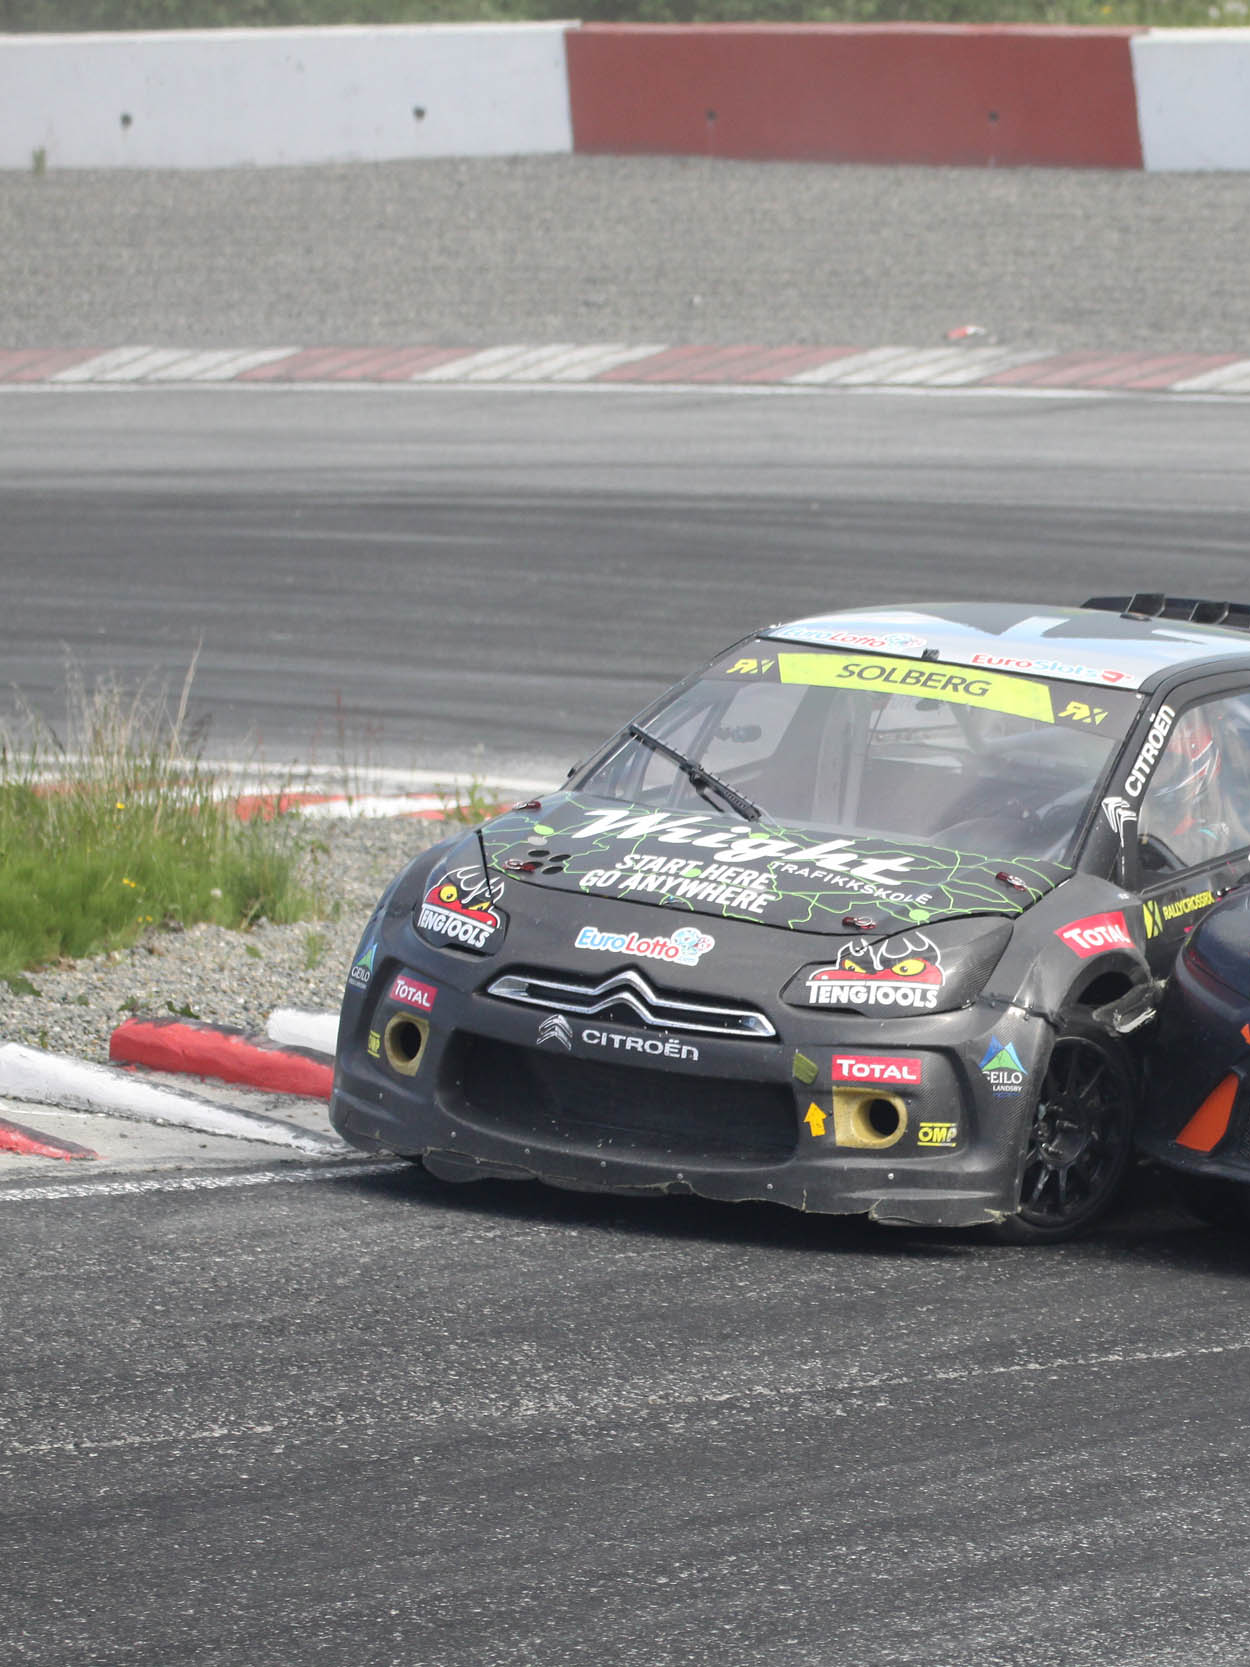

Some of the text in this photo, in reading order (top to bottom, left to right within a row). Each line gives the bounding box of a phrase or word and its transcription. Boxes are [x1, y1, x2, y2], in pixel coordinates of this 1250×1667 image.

[836, 663, 992, 698] SOLBERG
[615, 853, 779, 891] START HERE
[770, 861, 933, 906] TRAFIKKSKOLE
[579, 869, 778, 915] GO ANYWHERE
[578, 929, 680, 959] EuroLotto
[1062, 924, 1131, 949] TOTAL
[394, 980, 432, 1008] TOTAL
[806, 979, 940, 1009] TENGTOOLS
[836, 1059, 917, 1080] TOTAL
[918, 1127, 957, 1143] OMP
